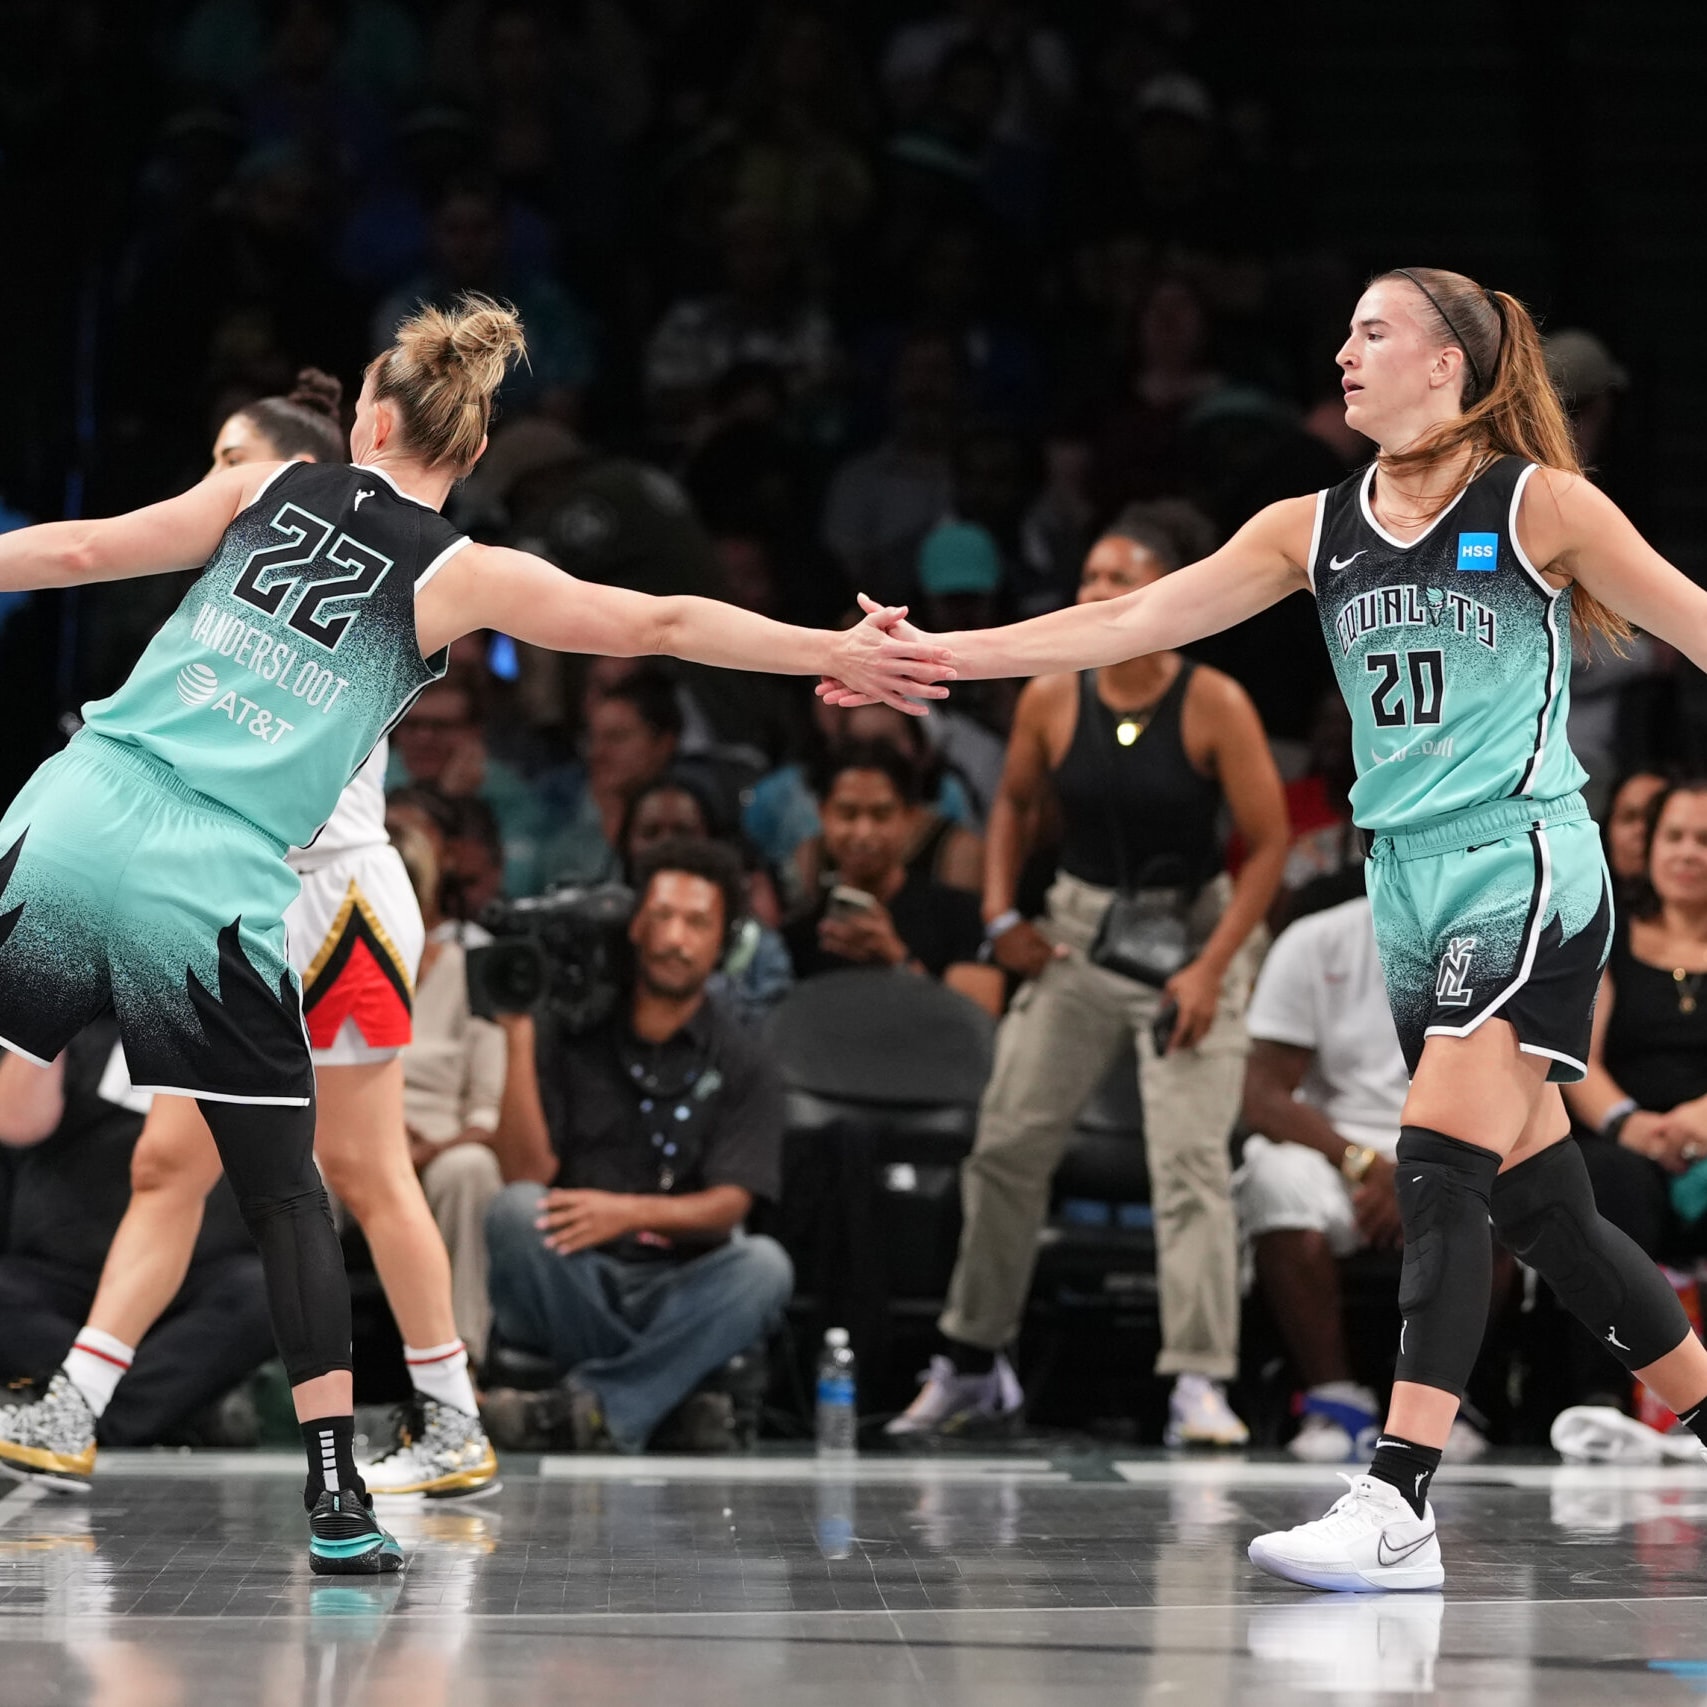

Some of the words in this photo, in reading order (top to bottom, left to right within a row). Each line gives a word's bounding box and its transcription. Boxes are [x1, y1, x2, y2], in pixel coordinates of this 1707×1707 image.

[231, 502, 395, 651] 22
[1462, 545, 1494, 558] HSS
[190, 602, 350, 714] VANDERSLOOT
[1365, 649, 1445, 728] 20
[211, 690, 295, 745] AT&T
